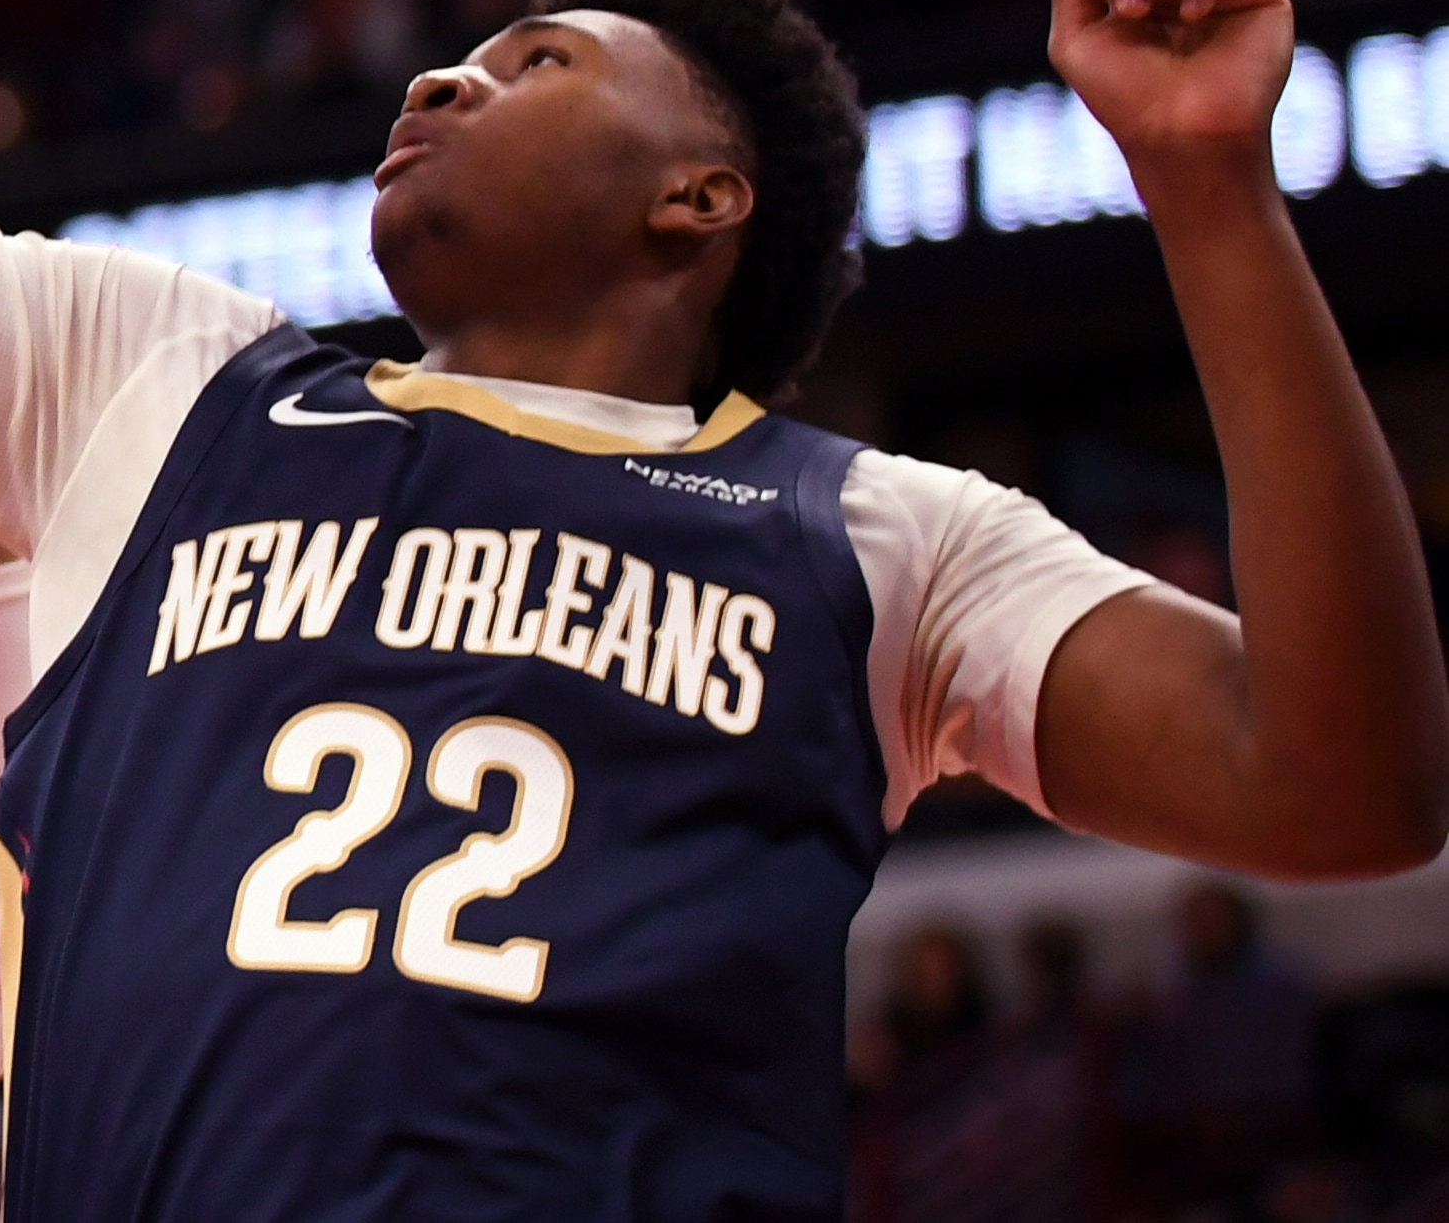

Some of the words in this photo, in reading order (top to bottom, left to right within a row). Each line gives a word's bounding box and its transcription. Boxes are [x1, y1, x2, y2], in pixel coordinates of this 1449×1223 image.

[147, 515, 380, 678] NEW
[375, 526, 777, 737] ORLEANS
[226, 701, 575, 1004] 22
